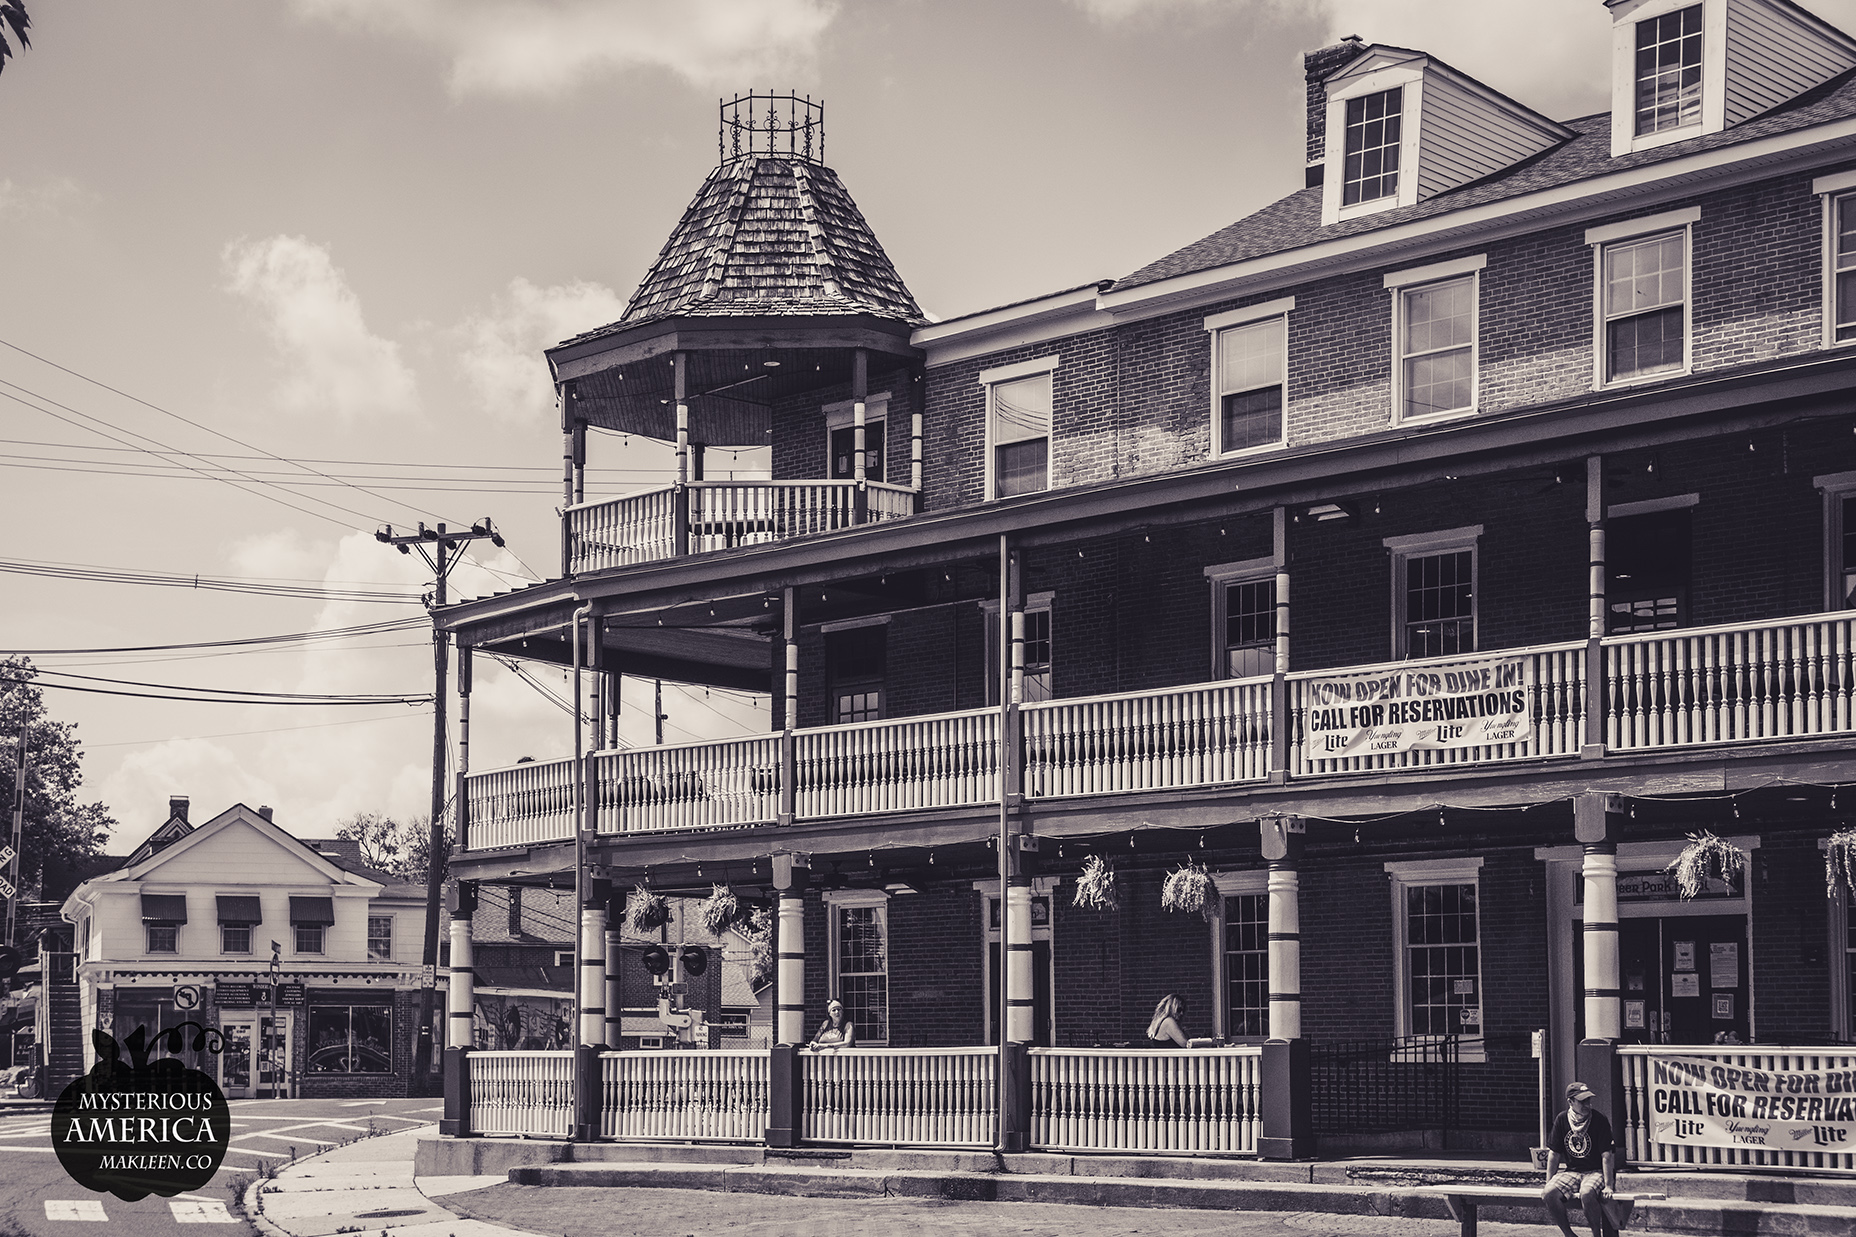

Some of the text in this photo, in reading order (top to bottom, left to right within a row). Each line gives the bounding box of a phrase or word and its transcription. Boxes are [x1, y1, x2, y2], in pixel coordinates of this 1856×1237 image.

[1311, 661, 1524, 706] NOW OPEN FOR DINE IN!
[1311, 689, 1525, 732] CALL FOR RESERVATIONS
[1480, 717, 1522, 732] Yuengling
[1325, 734, 1349, 752] Lite
[1365, 728, 1404, 741] Yuengling
[1436, 725, 1463, 743] Lite
[1486, 730, 1515, 740] LAGER
[1371, 740, 1398, 750] LAGER
[1616, 883, 1639, 893] eer
[1654, 1060, 1706, 1087] NOW
[1710, 1066, 1770, 1093] OPEN
[1775, 1073, 1820, 1094] FOR
[1654, 1088, 1703, 1115] CALL
[1706, 1092, 1746, 1118] FOR
[1674, 1118, 1705, 1139] Lite
[1725, 1119, 1771, 1136] Yuengling
[1812, 1125, 1847, 1147] Lite
[1733, 1135, 1766, 1146] LAGER
